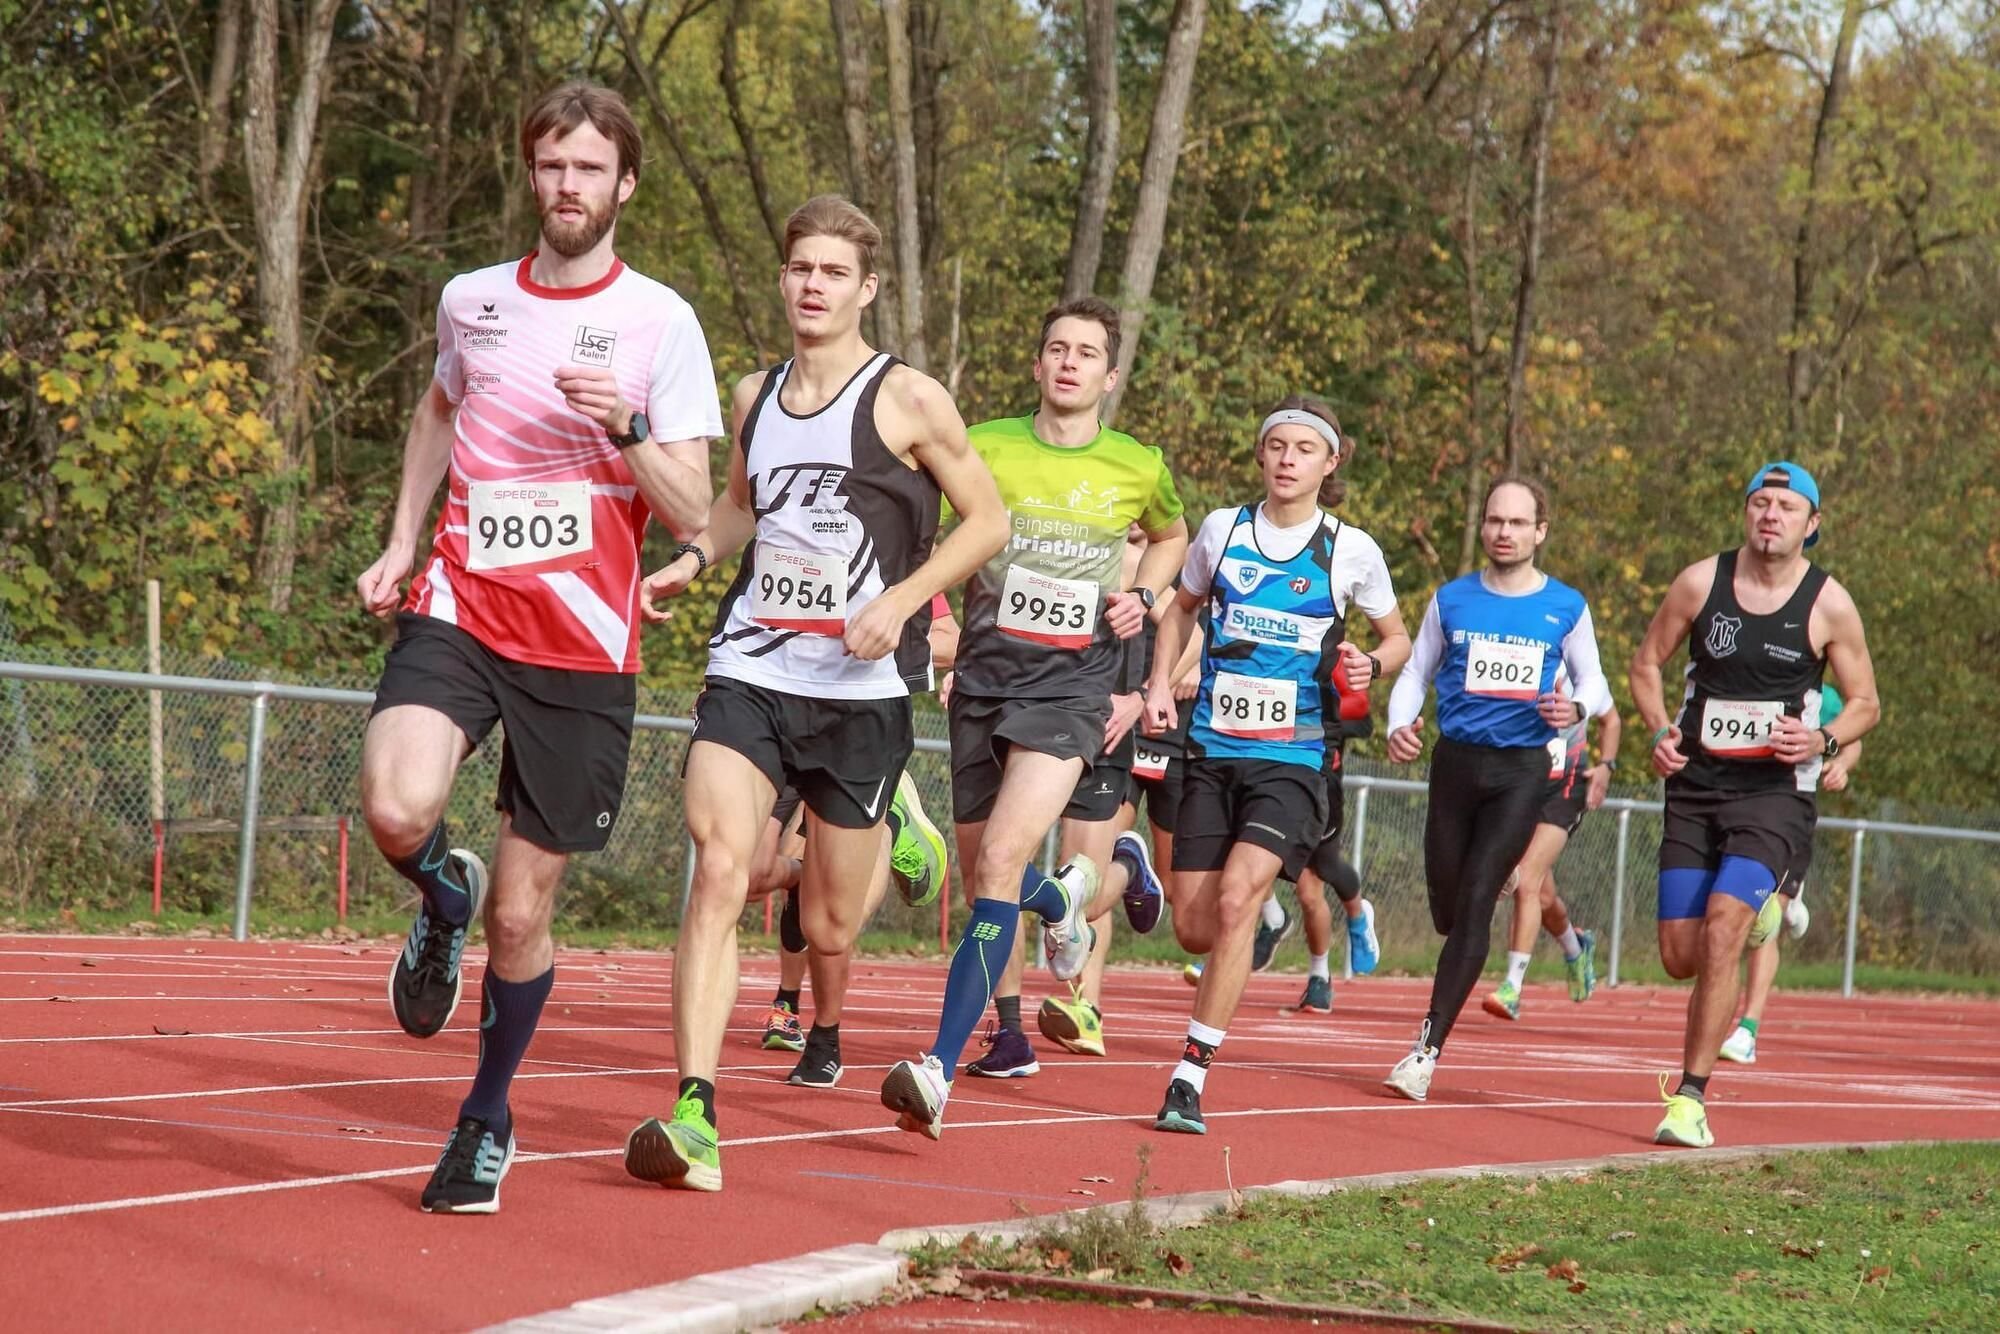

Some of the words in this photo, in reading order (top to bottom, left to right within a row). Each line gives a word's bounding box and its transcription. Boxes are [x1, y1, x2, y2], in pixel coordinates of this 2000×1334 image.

[468, 329, 509, 338] INTERSPORT
[579, 348, 607, 361] Aalen
[493, 490, 537, 499] SPEED
[478, 514, 580, 549] 9803
[812, 519, 848, 529] panzeri
[1015, 513, 1089, 538] einstein
[1012, 532, 1110, 560] triathlon
[774, 553, 806, 566] SPEED
[761, 572, 836, 613] 9954
[1028, 576, 1061, 591] SPEED
[1010, 591, 1087, 629] 9953
[1232, 609, 1299, 635] Sparda
[1466, 631, 1500, 643] TELIS
[1474, 659, 1534, 685] 9802
[1219, 694, 1287, 723] 9818
